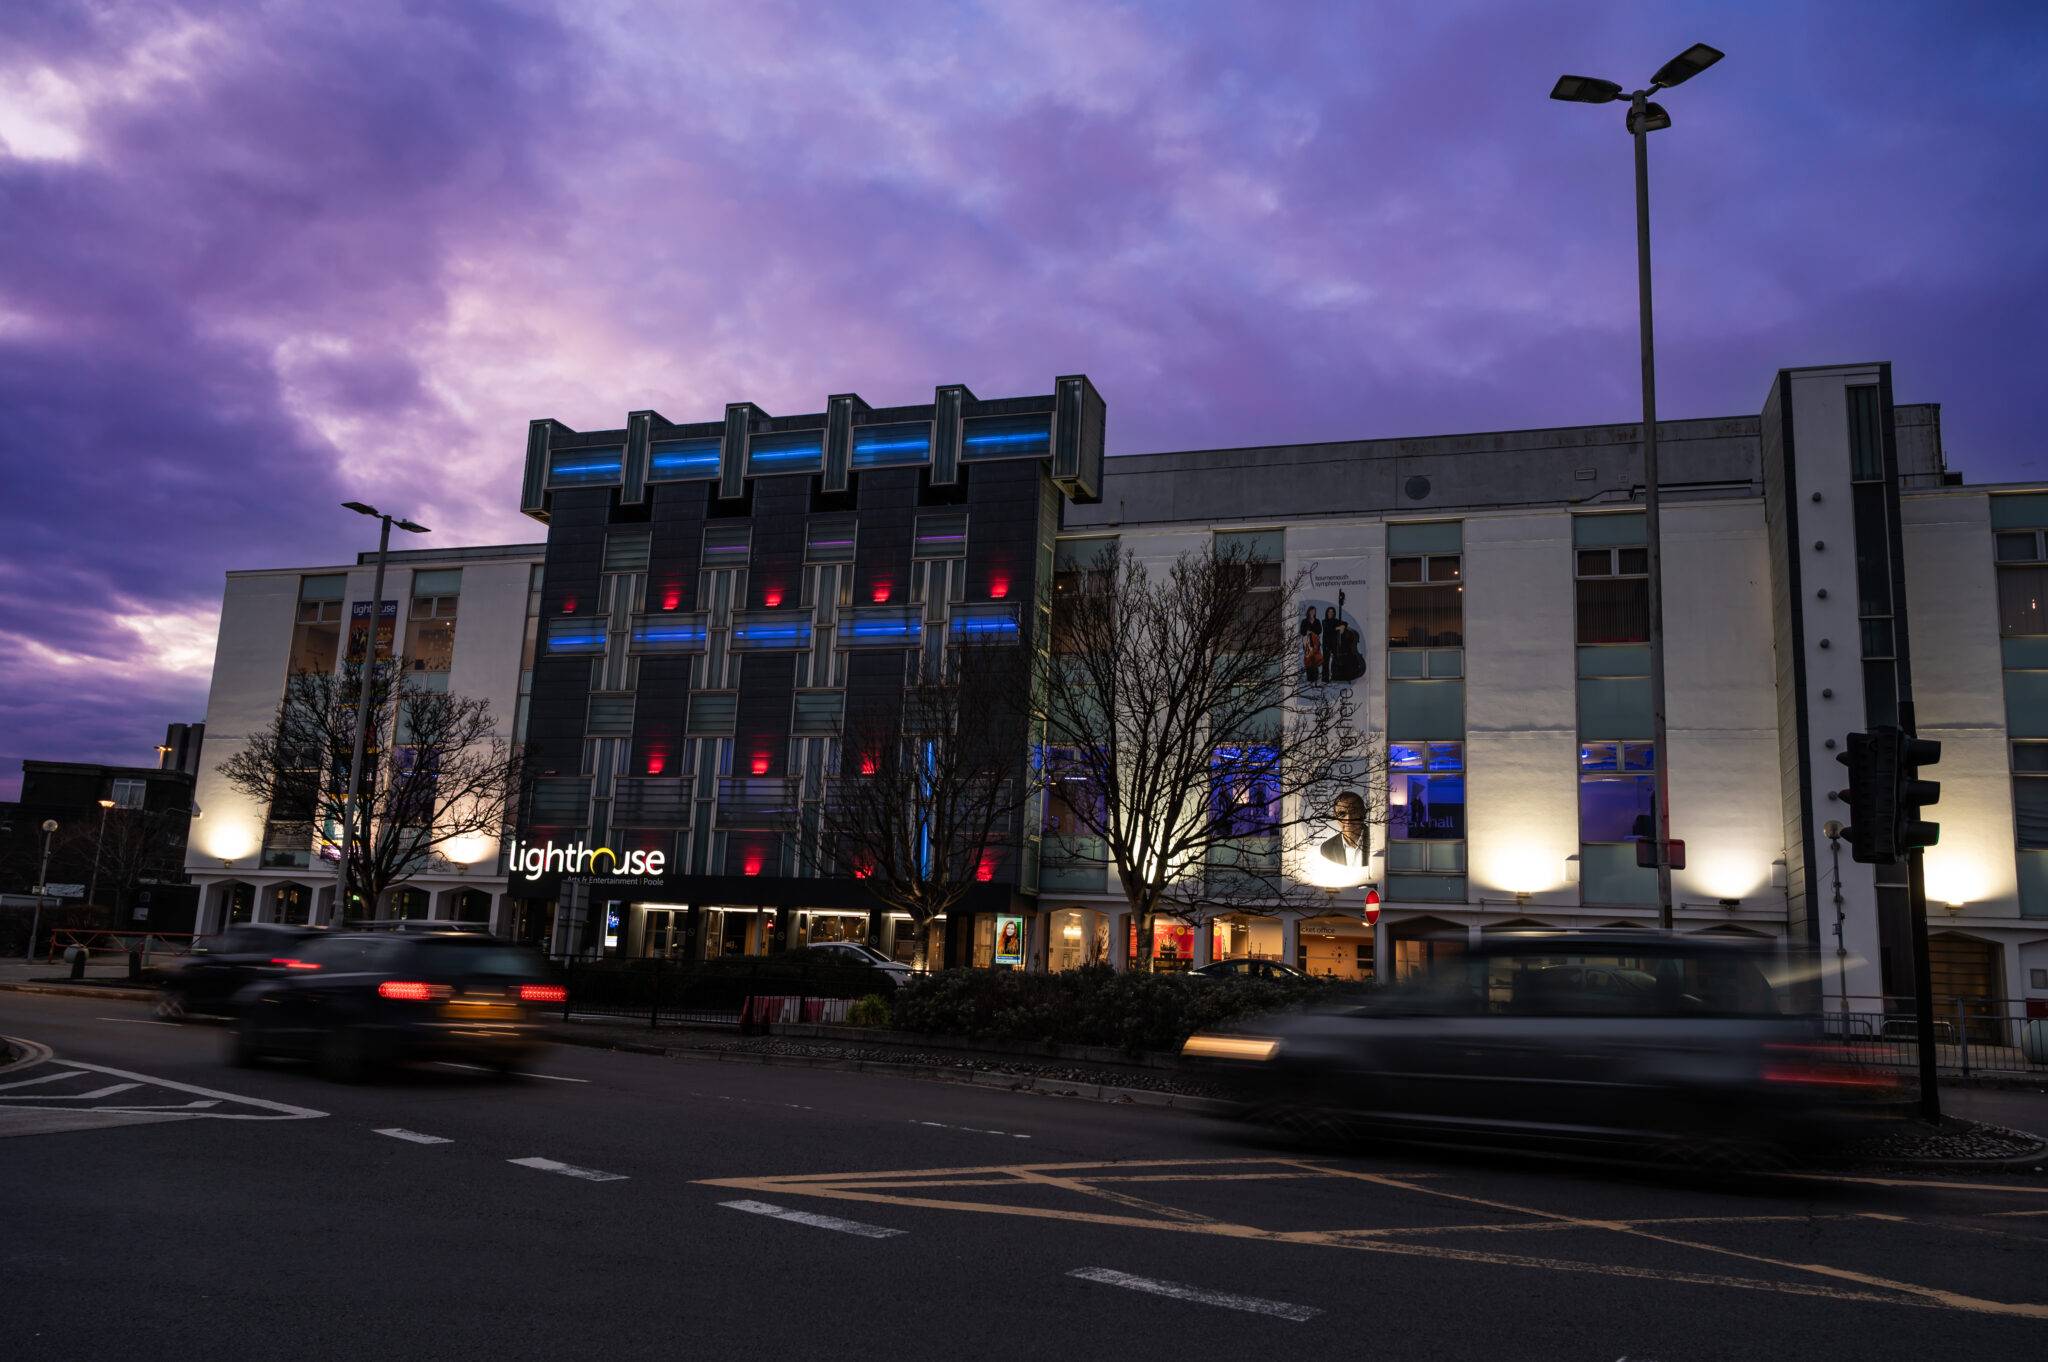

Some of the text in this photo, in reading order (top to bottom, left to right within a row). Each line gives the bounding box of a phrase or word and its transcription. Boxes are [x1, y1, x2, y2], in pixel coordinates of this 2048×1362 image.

[353, 604, 396, 616] lightuse
[509, 840, 665, 881] lighthouse
[588, 876, 638, 886] Entertainment
[643, 878, 664, 886] Poole
